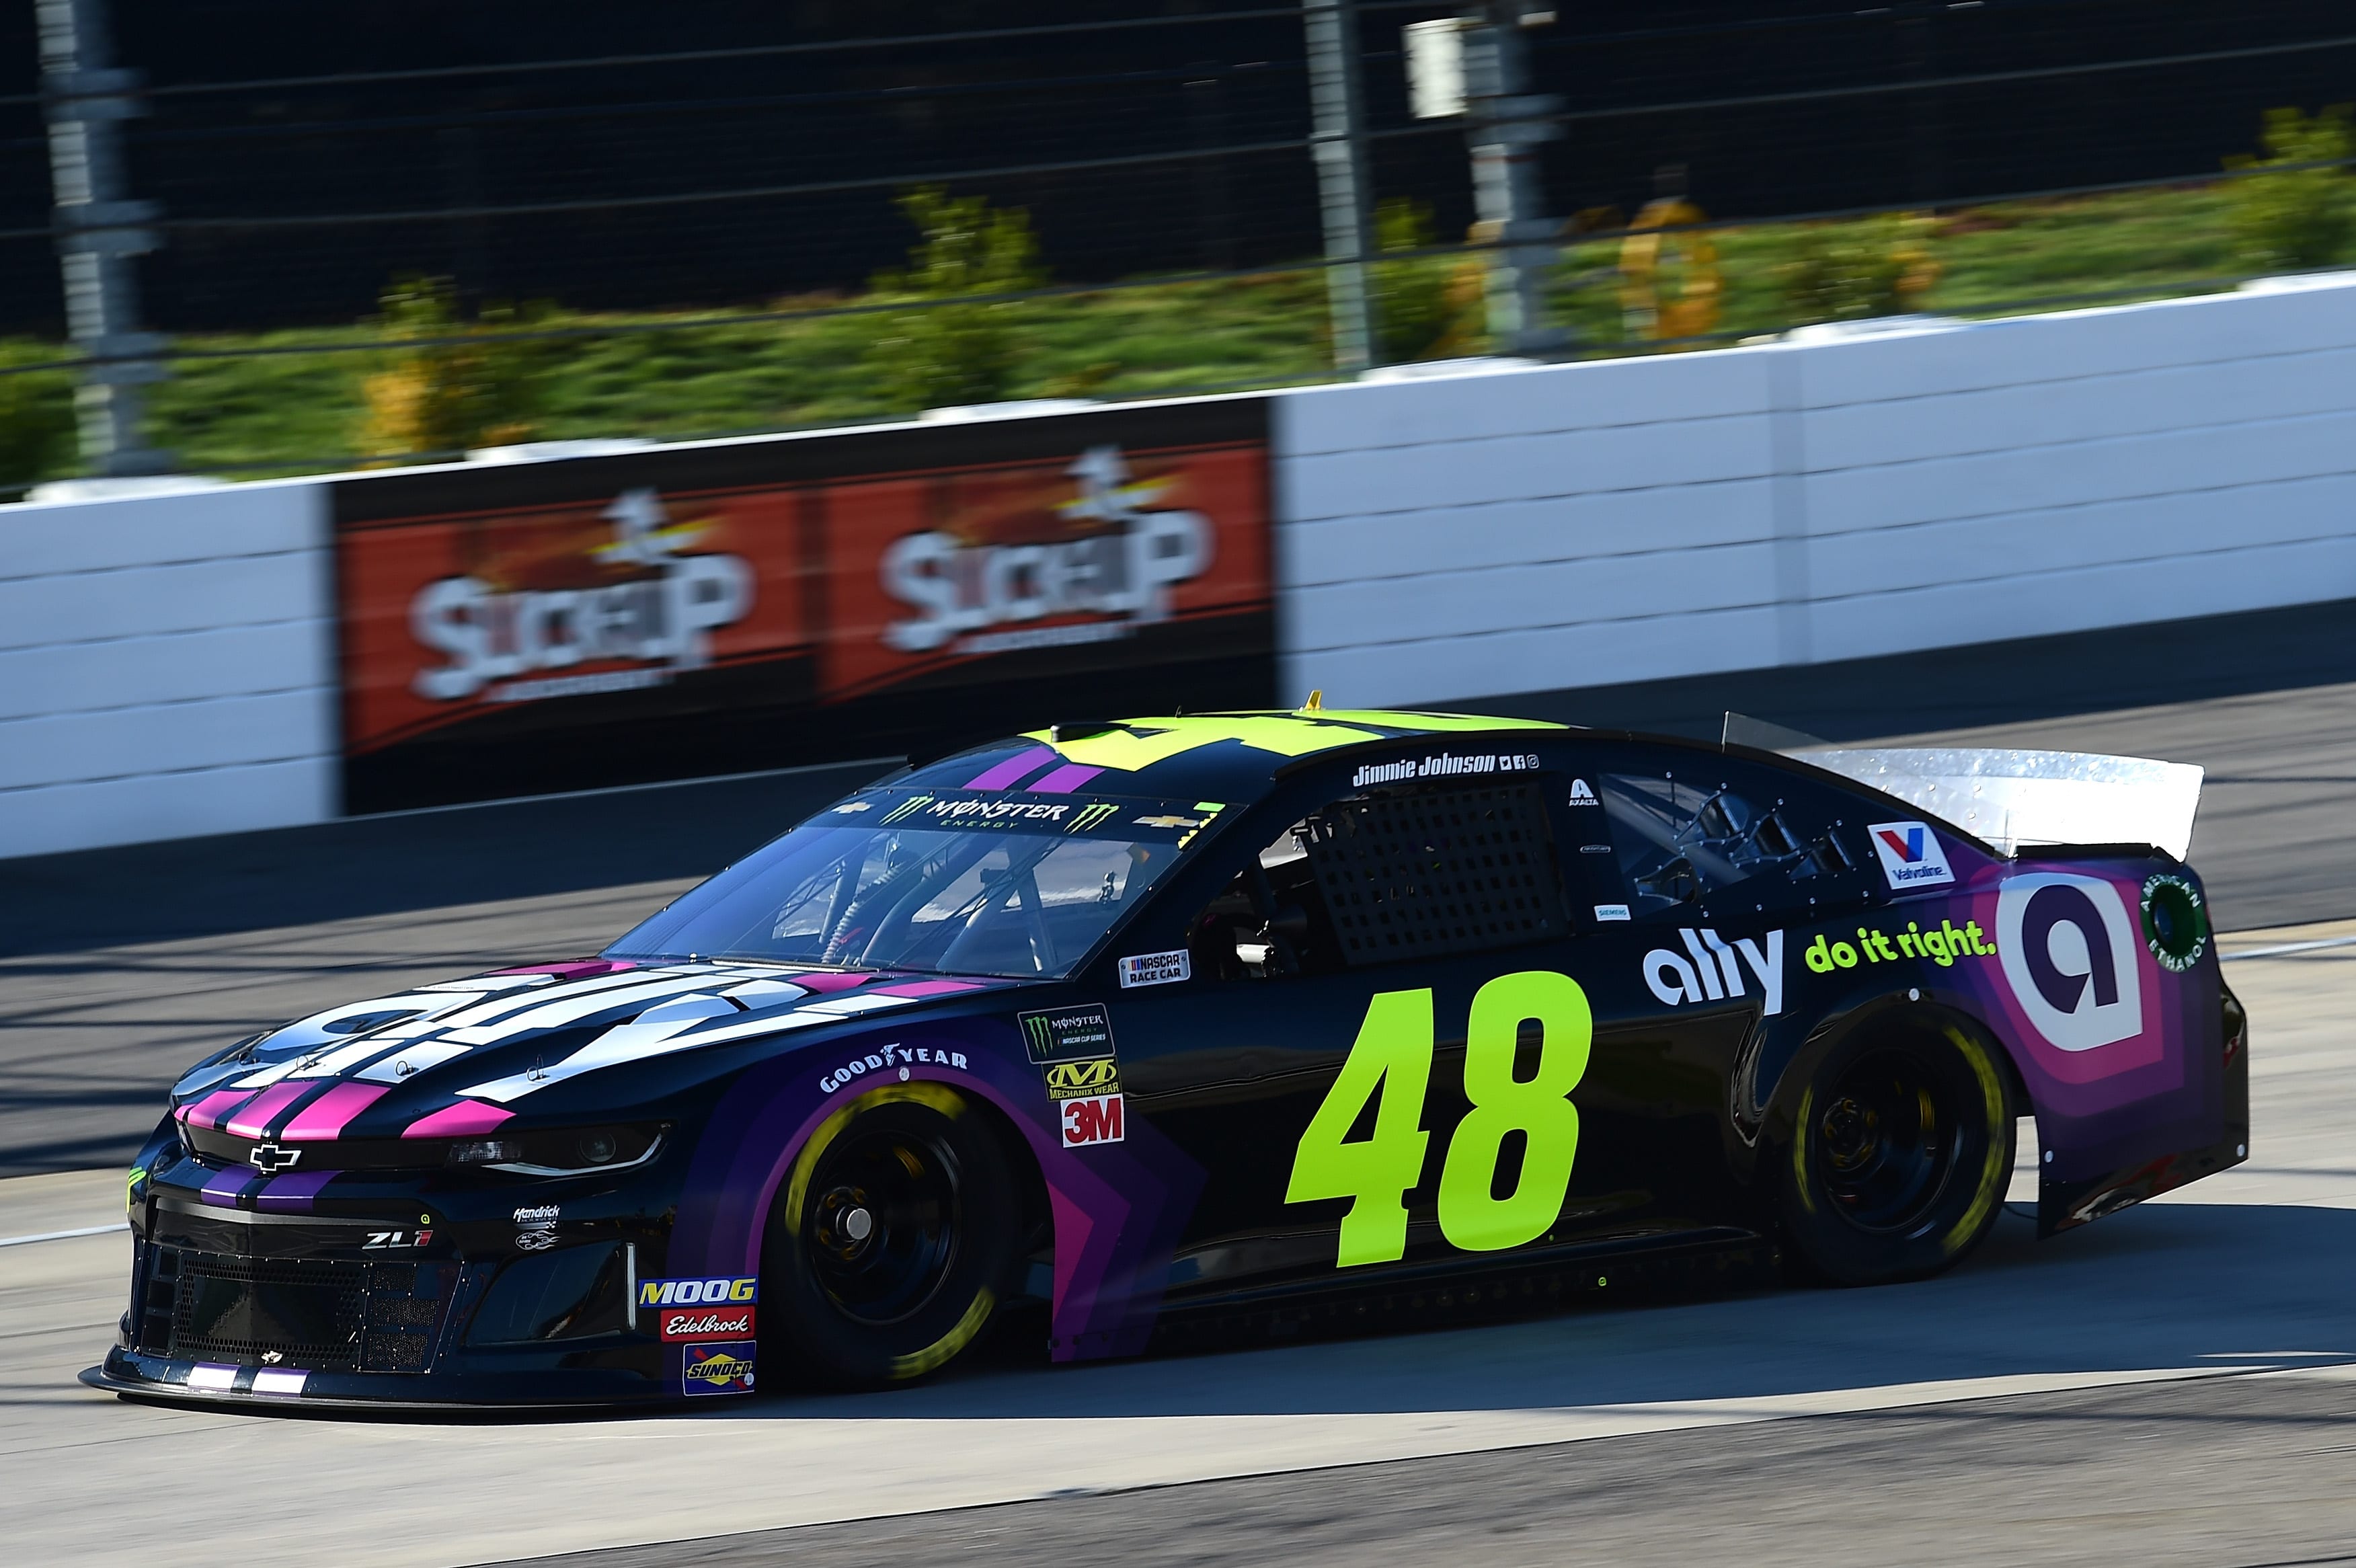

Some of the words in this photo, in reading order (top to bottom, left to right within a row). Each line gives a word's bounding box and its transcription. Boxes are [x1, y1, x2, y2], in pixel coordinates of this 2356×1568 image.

[1353, 759, 1416, 787] Jimmie
[1418, 752, 1495, 776] Johnson
[940, 820, 1019, 828] ENERGY
[1891, 865, 1945, 881] Valvoline
[1805, 935, 1858, 972] do
[1858, 927, 1899, 963] it
[2148, 937, 2207, 972] ETHANOL
[1140, 954, 1180, 970] NASCAR
[1130, 971, 1157, 983] RACE
[1160, 968, 1181, 979] CAR
[1643, 928, 1783, 1017] ally
[1063, 1036, 1081, 1044] NASCAR
[1091, 1033, 1106, 1042] SERIES
[1049, 1089, 1093, 1099] MECHANIX
[1094, 1082, 1120, 1095] WEAR
[1064, 1097, 1122, 1144] 3M
[1284, 971, 1593, 1268] 48
[513, 1205, 560, 1222] Hendrick
[362, 1230, 433, 1250] ZL1
[639, 1278, 756, 1304] MOOG
[666, 1315, 748, 1335] Edelbrock
[688, 1362, 752, 1378] SUNOCO
